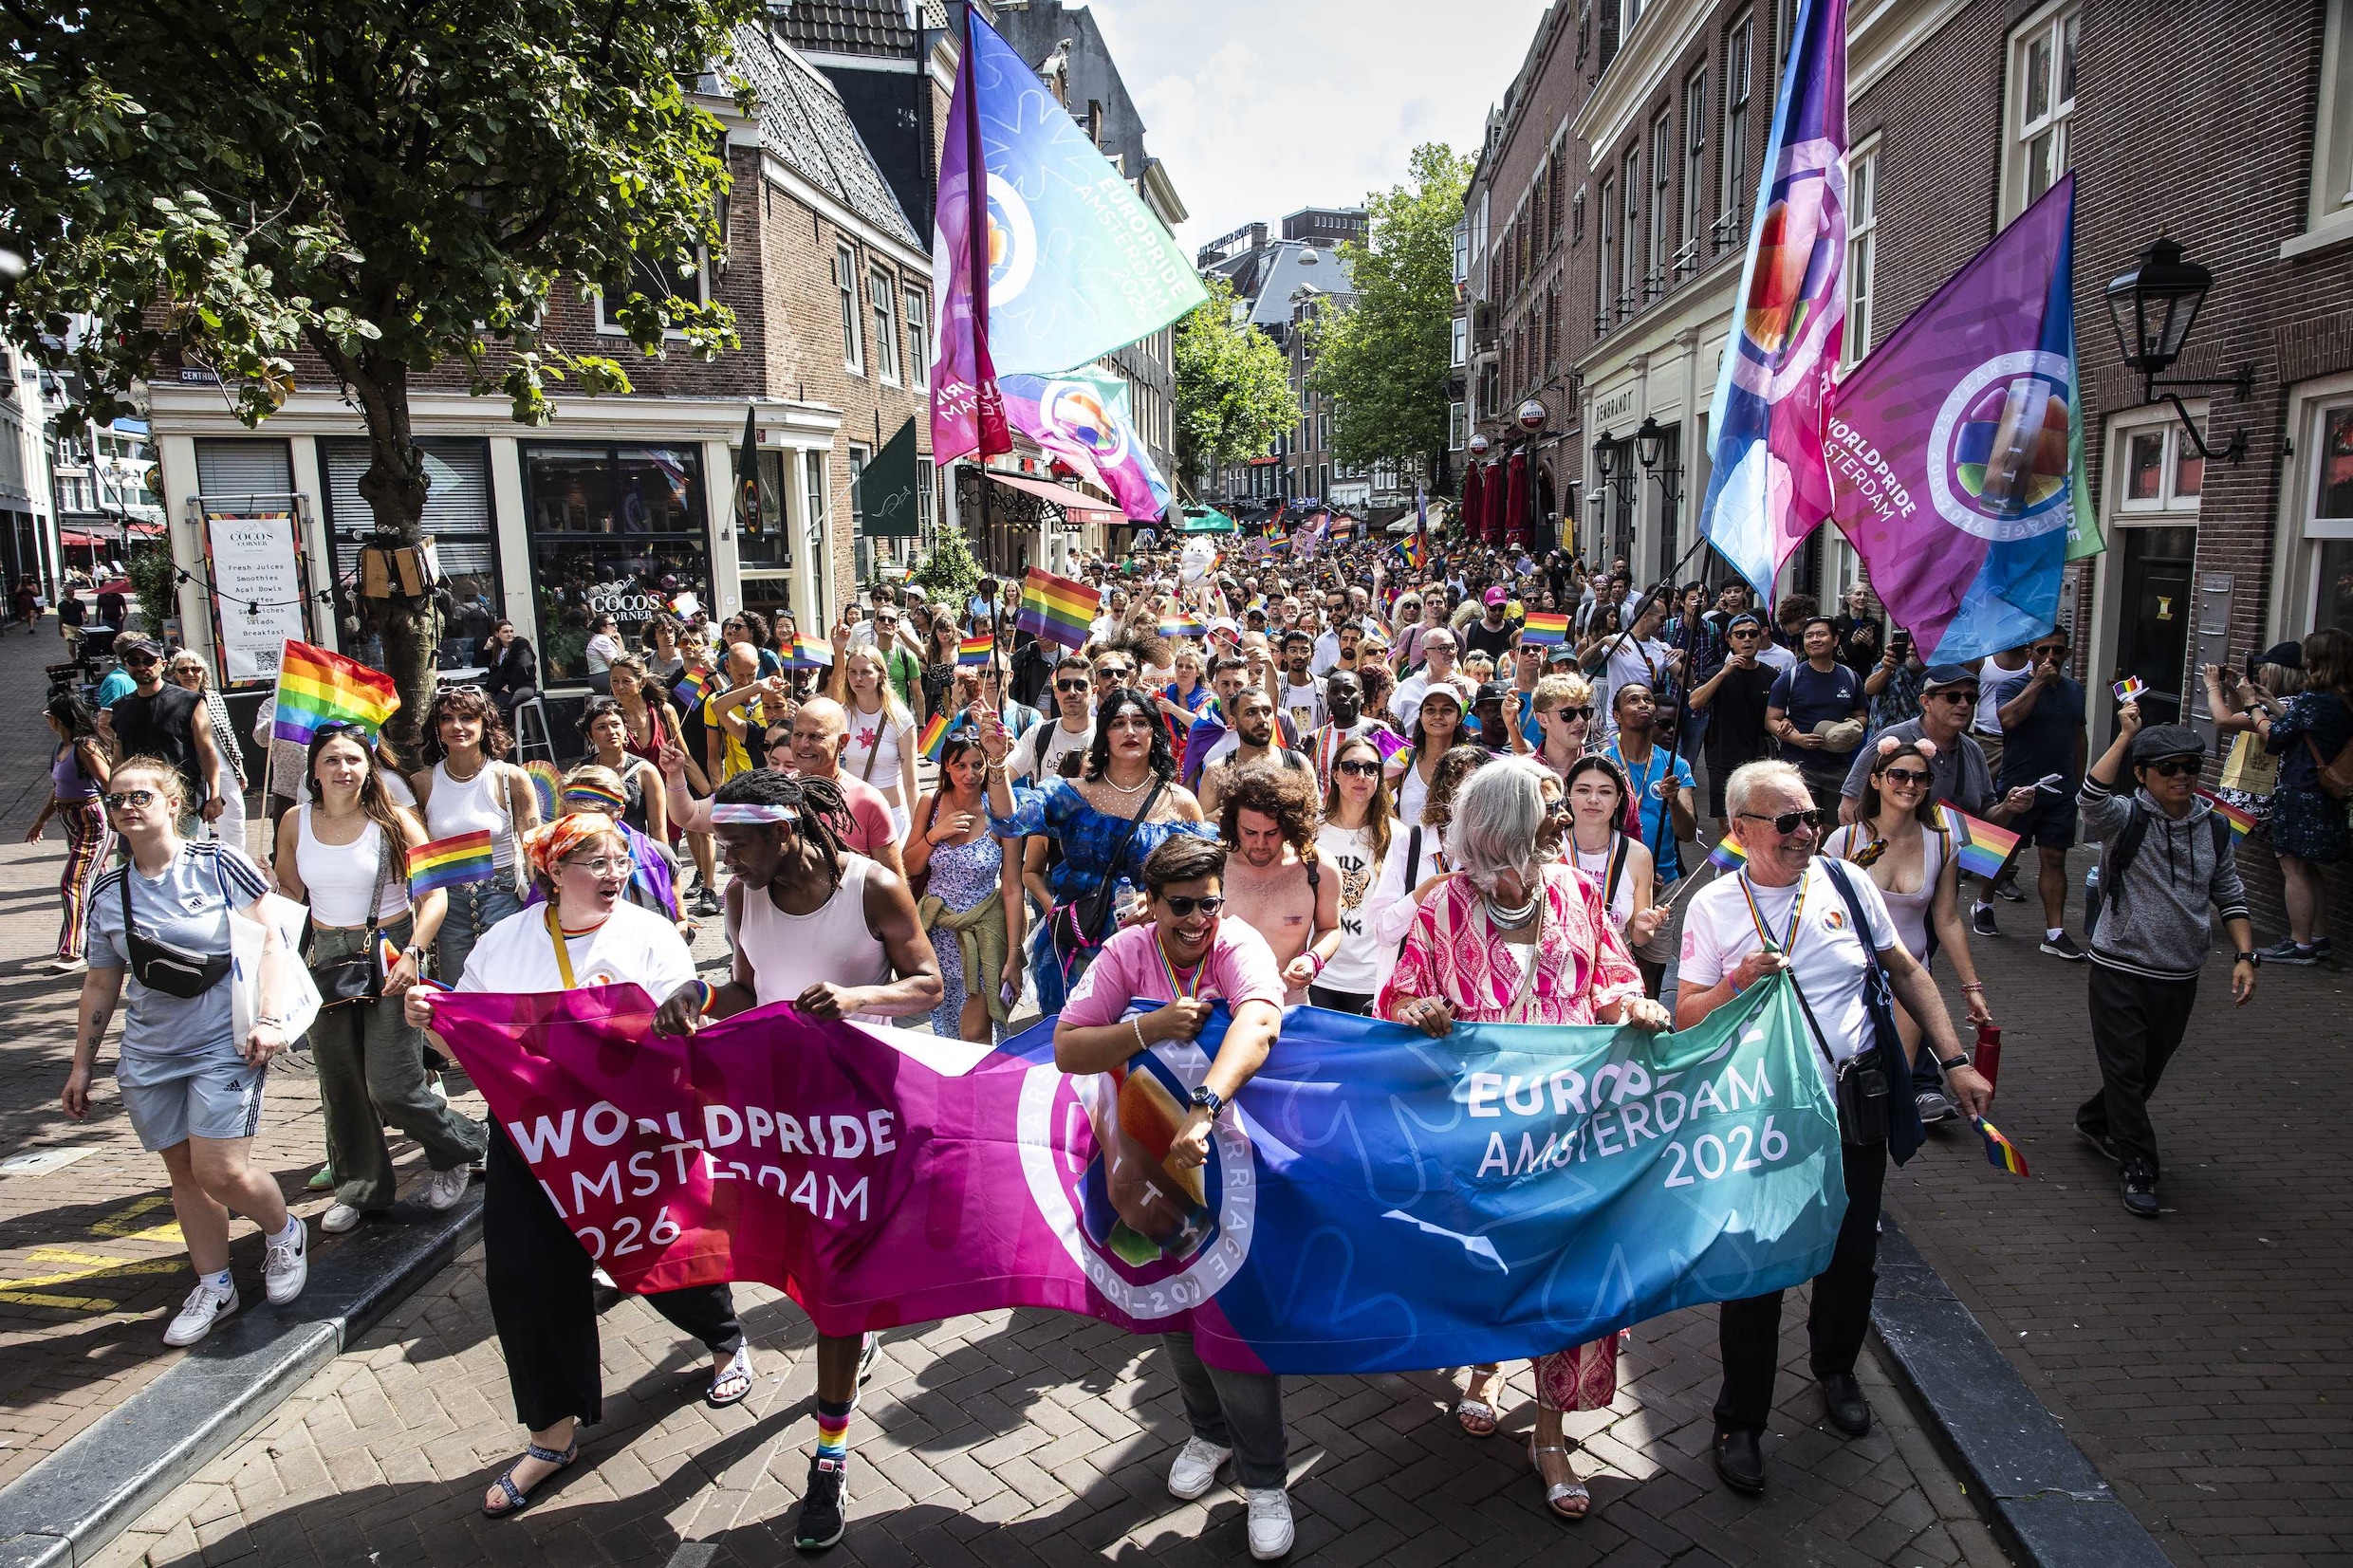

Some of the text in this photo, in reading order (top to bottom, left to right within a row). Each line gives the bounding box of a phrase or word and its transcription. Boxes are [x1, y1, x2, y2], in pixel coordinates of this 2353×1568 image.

[1075, 186, 1169, 309] AMSTERDAM
[1098, 176, 1188, 298] EUROPRIDE
[1112, 267, 1148, 320] 2026
[1595, 390, 1633, 425] REMBRANDT
[1936, 354, 2050, 436] 25 YEARS OF
[1824, 440, 1896, 523] STERDAM
[590, 594, 660, 613] COCOS
[611, 610, 653, 621] ORNER
[1023, 1069, 1055, 1179] YEARS
[1476, 1058, 1775, 1178] AMSTERDAM
[1660, 1115, 1789, 1189] 2026
[575, 1205, 681, 1262] 026
